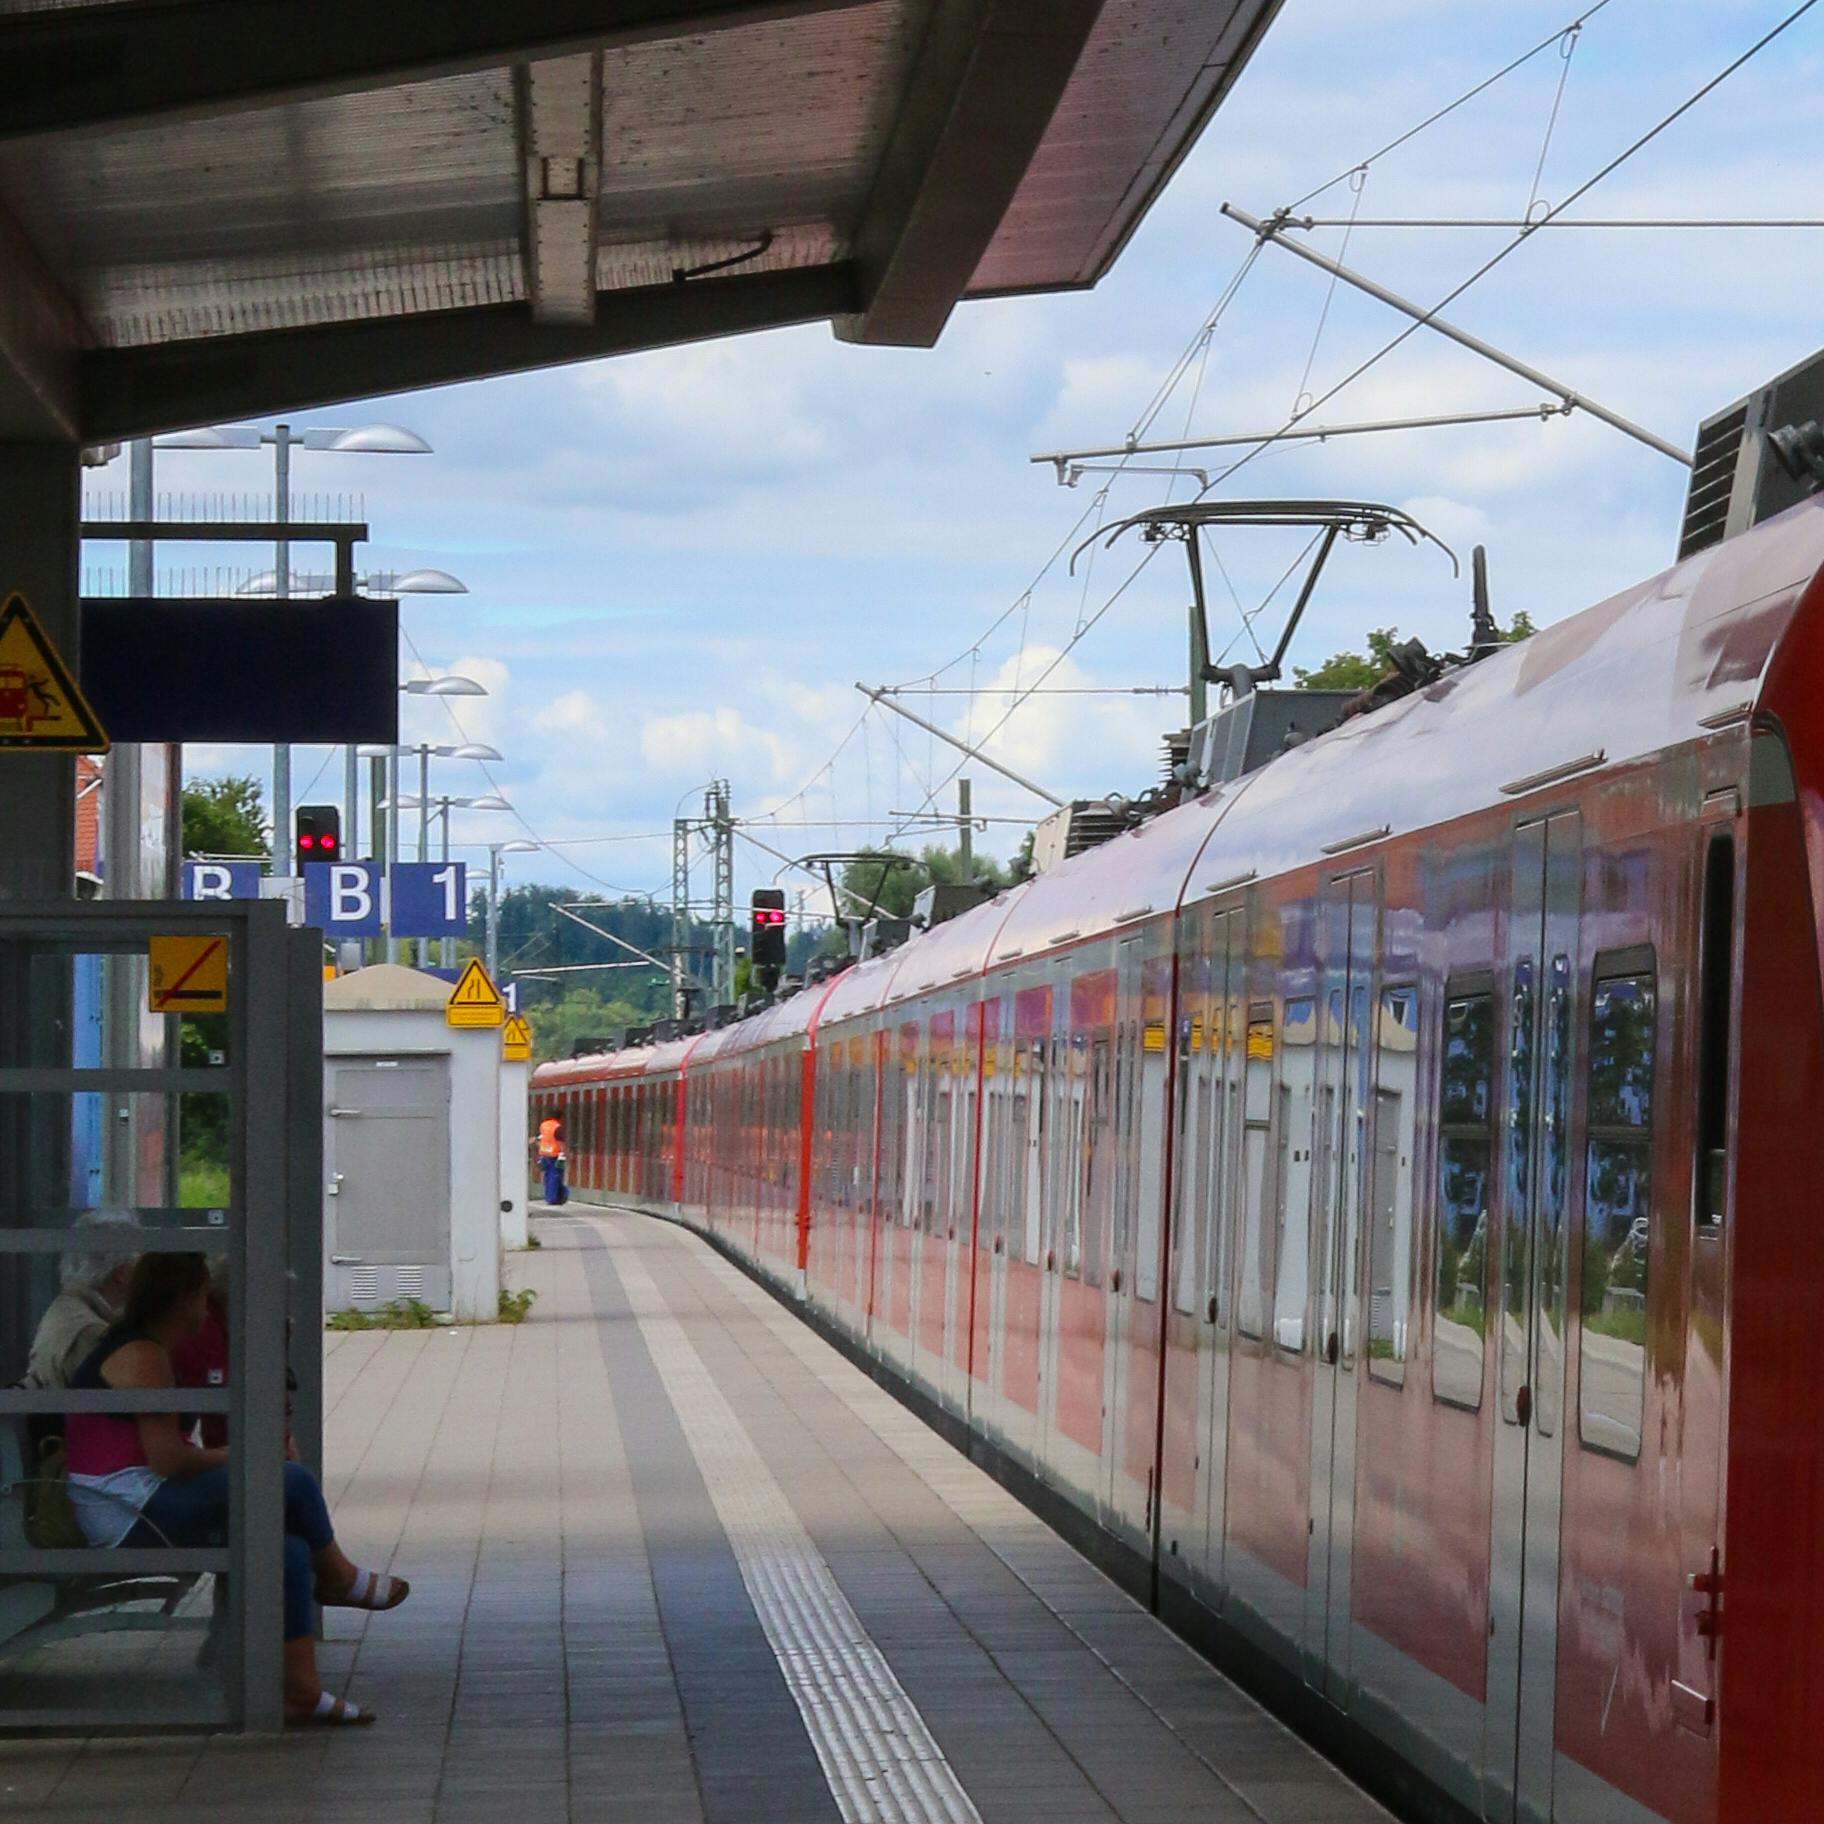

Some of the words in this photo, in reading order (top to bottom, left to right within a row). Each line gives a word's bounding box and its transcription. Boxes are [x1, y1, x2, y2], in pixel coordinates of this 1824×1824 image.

[330, 865, 373, 922] B
[432, 865, 457, 921] 1
[502, 982, 517, 1013] 1
